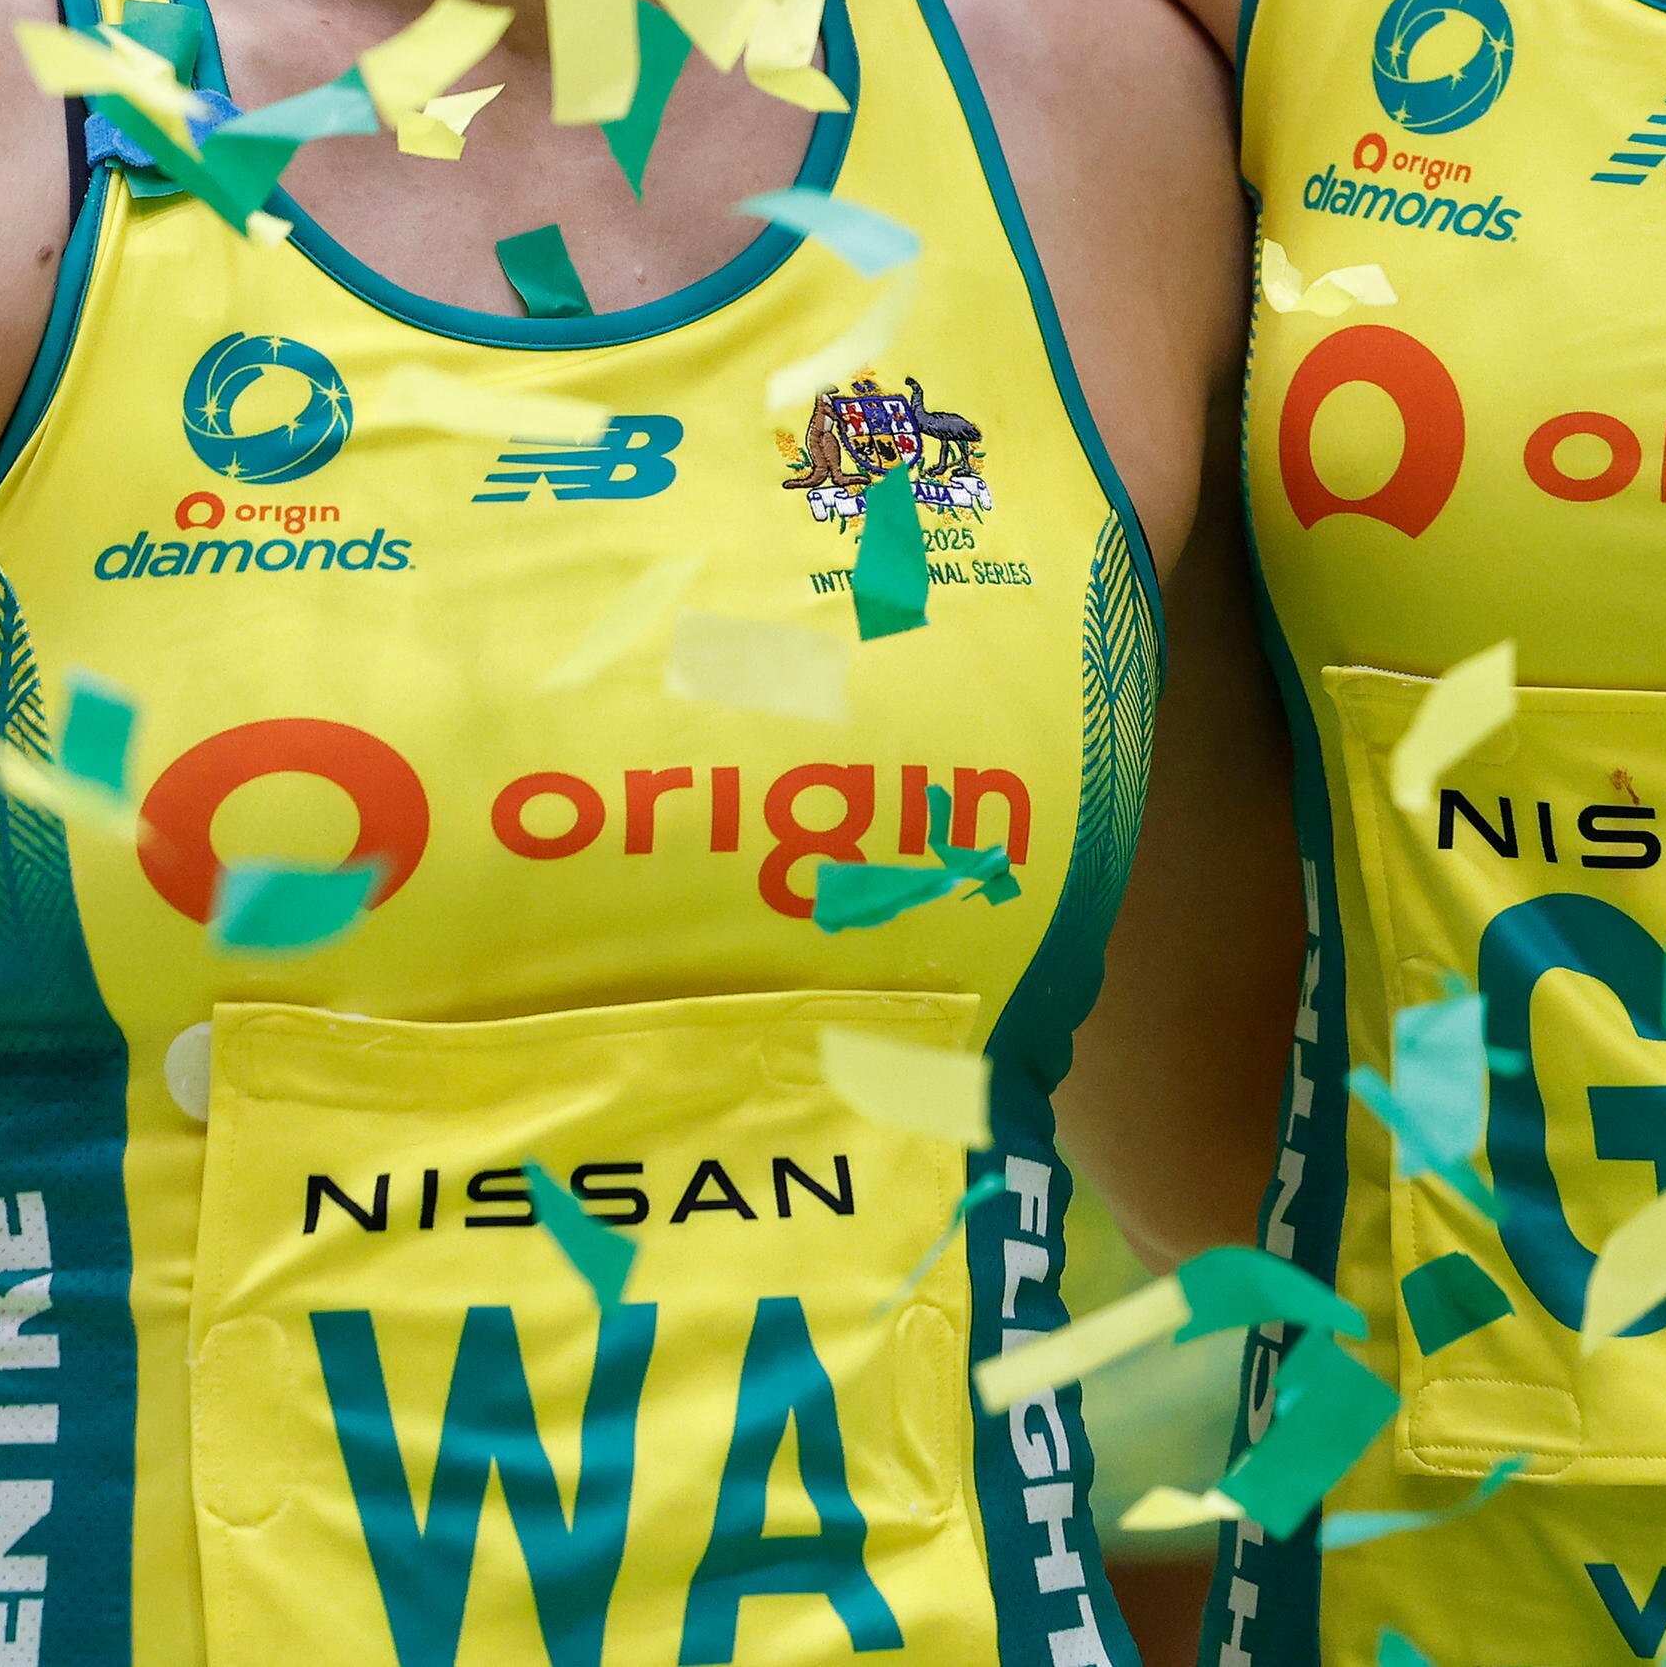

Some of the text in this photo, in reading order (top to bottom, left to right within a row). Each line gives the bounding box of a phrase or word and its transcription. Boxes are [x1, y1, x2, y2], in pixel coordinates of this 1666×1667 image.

[1303, 164, 1522, 242] diamonds
[1393, 152, 1472, 191] origin
[235, 504, 340, 534] origin
[94, 528, 412, 581] diamonds
[972, 559, 1032, 586] SERIES
[491, 763, 1031, 920] origin
[303, 1154, 856, 1234] NISSAN
[308, 1296, 905, 1667] WA
